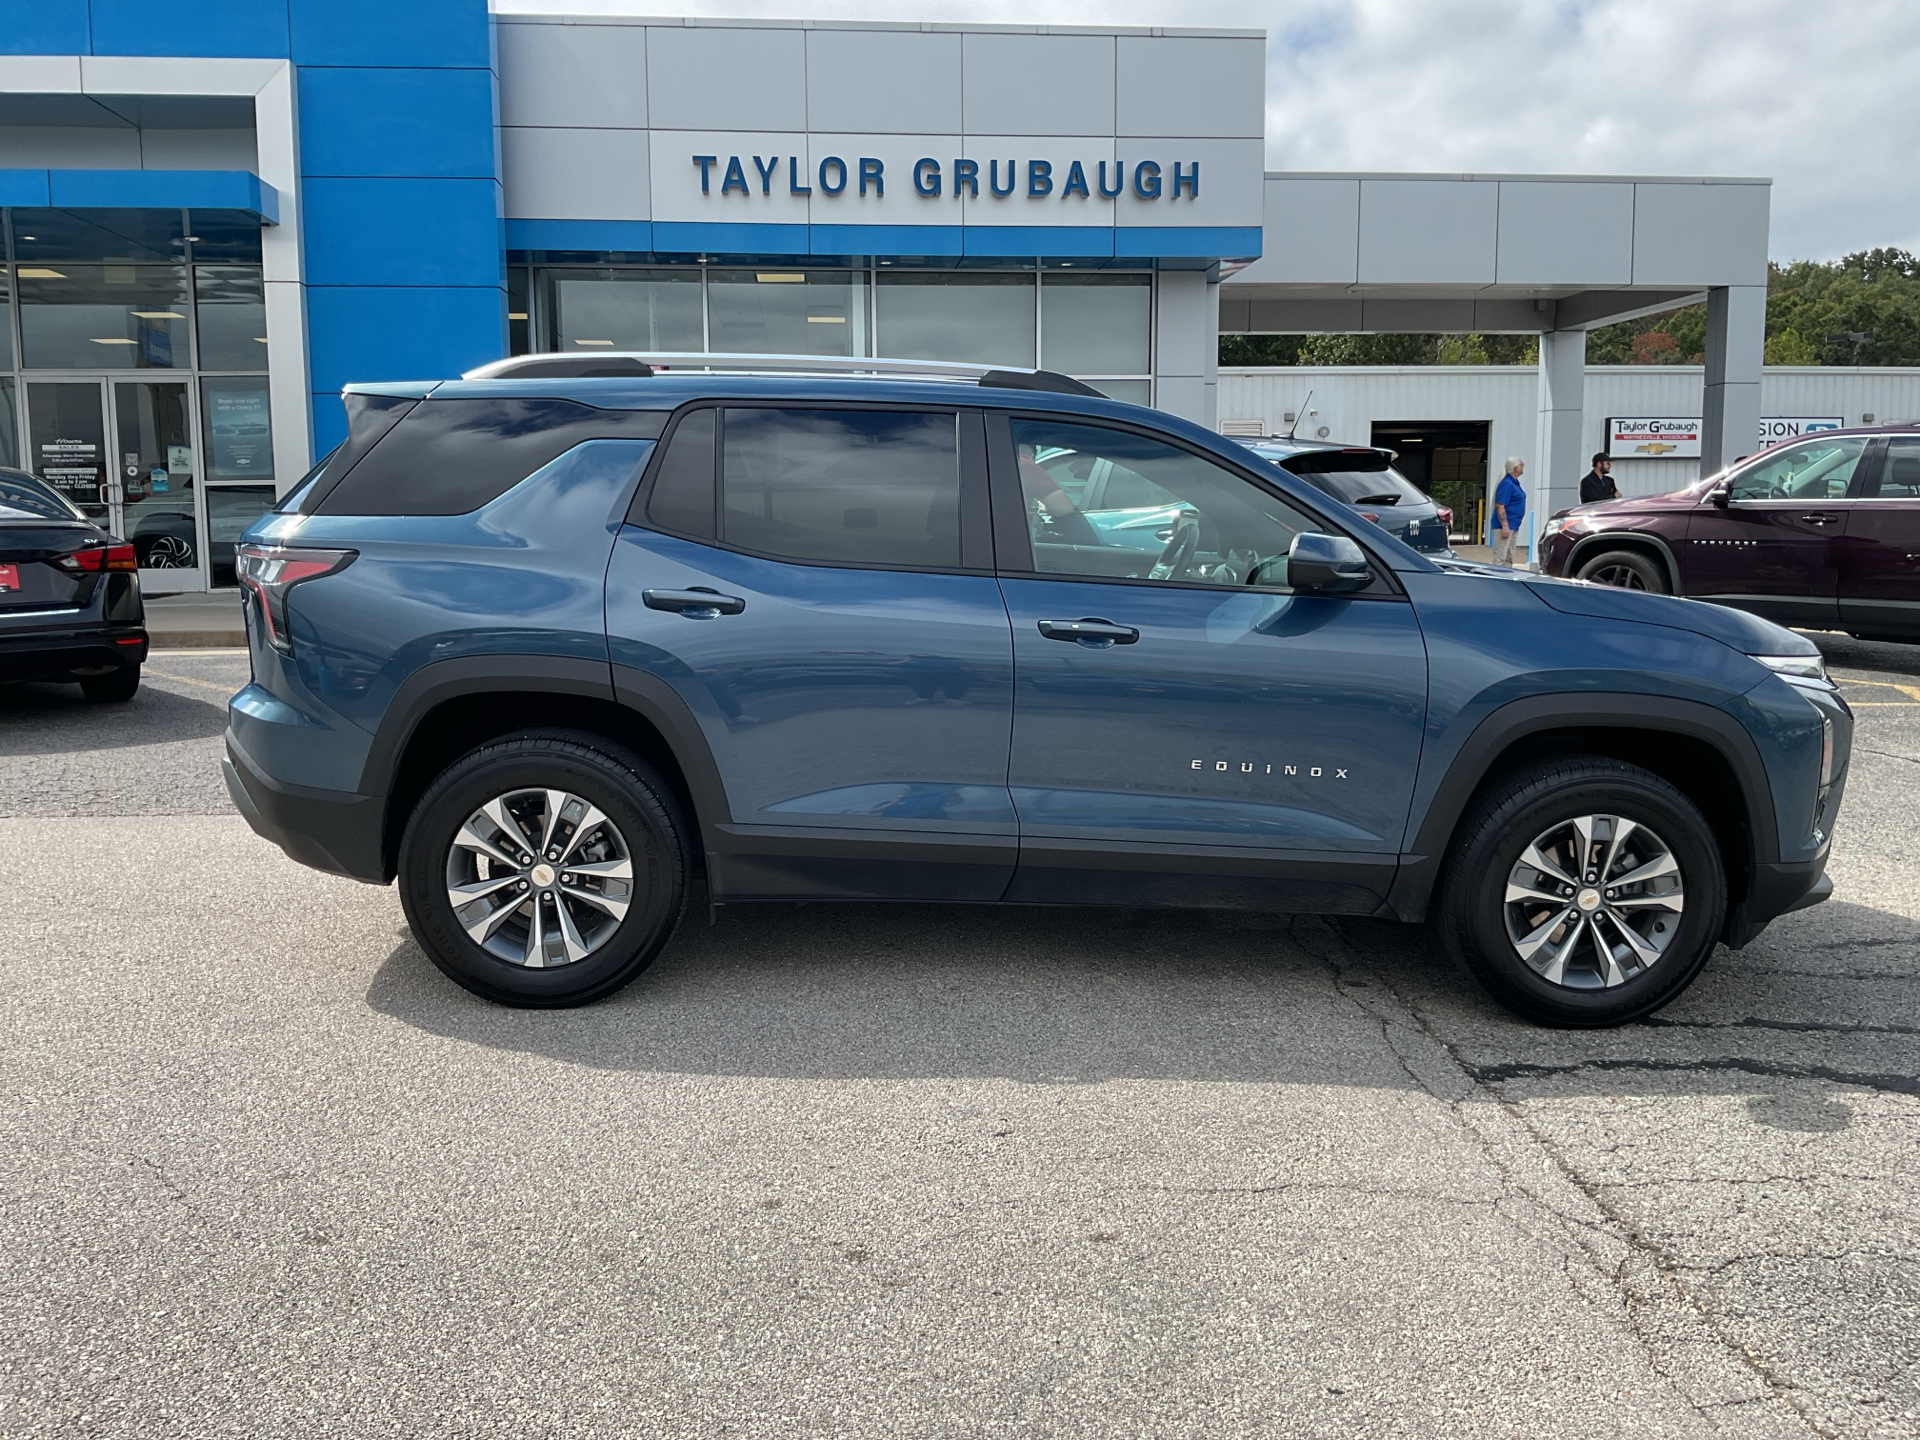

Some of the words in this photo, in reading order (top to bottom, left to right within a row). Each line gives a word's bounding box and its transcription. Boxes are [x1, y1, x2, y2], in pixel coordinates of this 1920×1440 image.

[692, 154, 885, 198] TAYLOR
[913, 157, 1200, 201] GRUBAUGH
[1615, 421, 1648, 434] Taylor
[1649, 421, 1698, 434] Grubaugh
[1759, 422, 1799, 436] SION
[1190, 759, 1349, 779] EQUINOX
